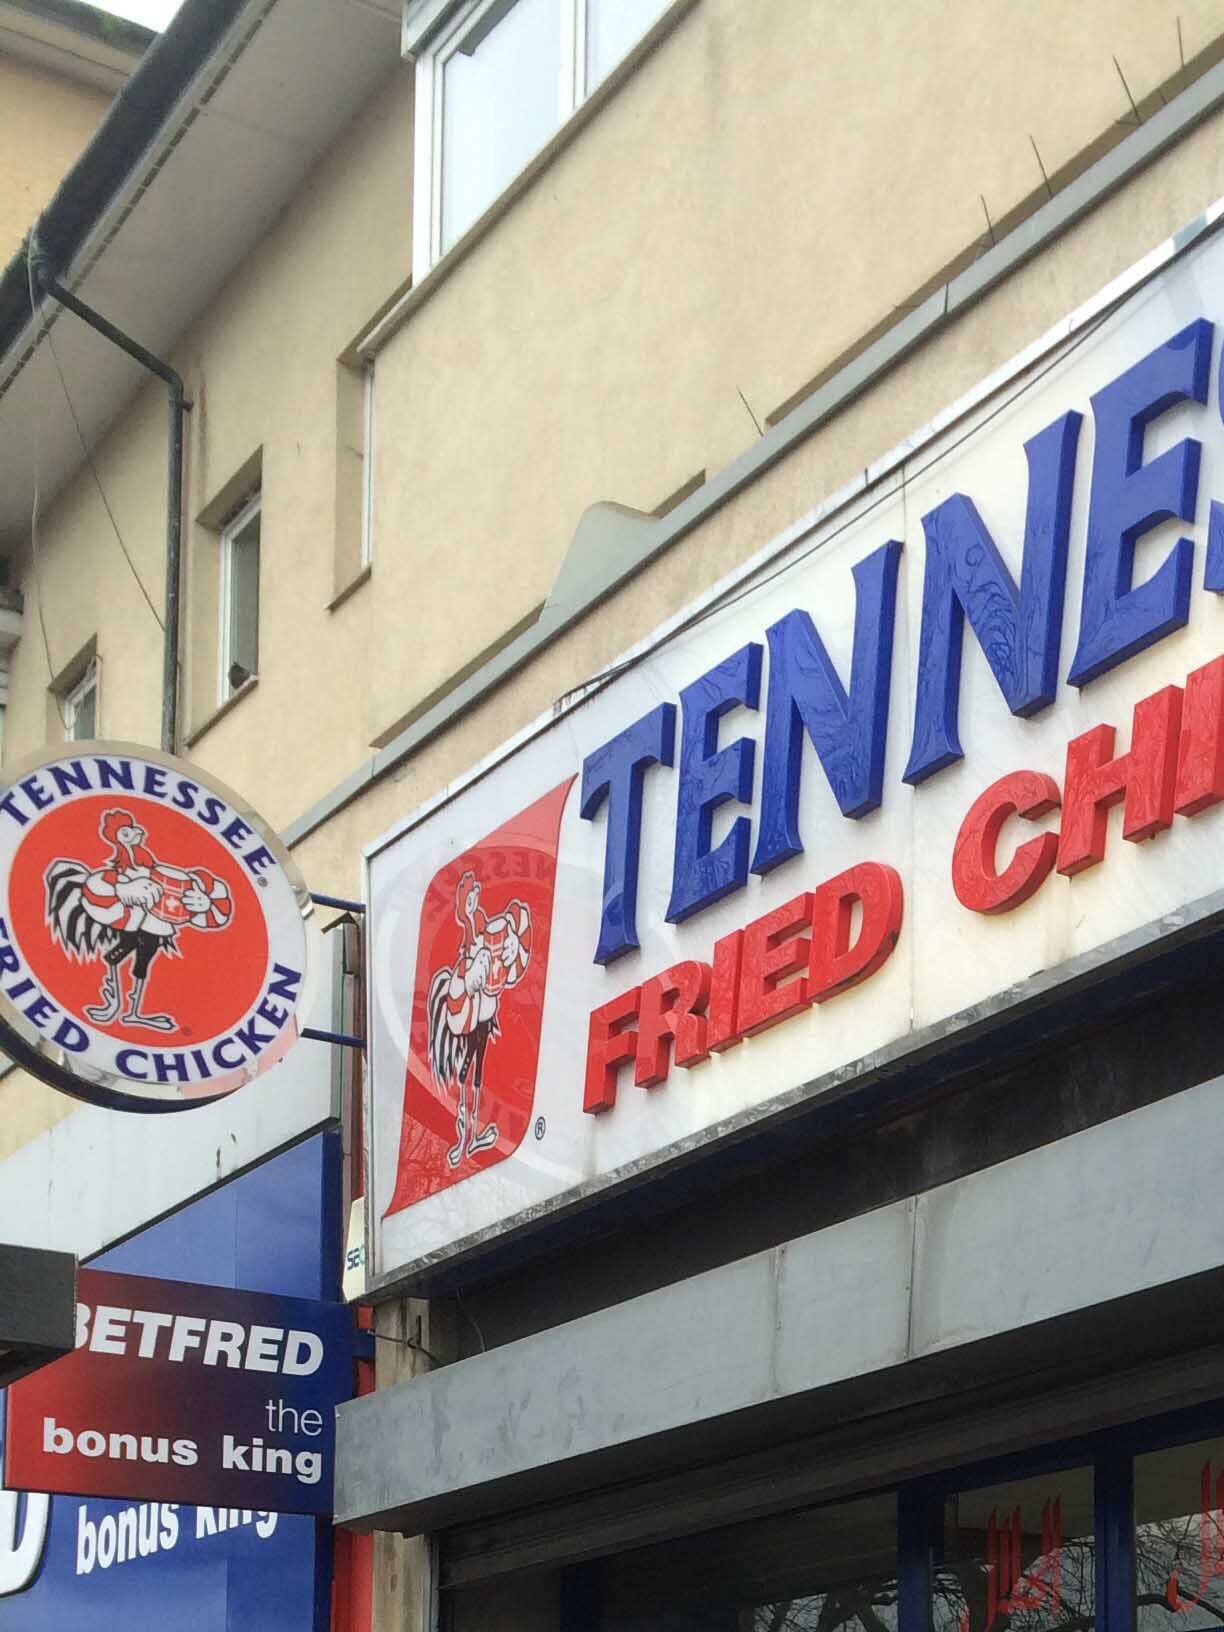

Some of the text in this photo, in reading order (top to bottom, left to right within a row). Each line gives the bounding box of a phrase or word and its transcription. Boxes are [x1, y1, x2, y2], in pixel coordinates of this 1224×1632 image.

[0, 757, 277, 876] TENNESSEE
[115, 962, 302, 1083] CHICKEN
[583, 861, 904, 1114] FRIED
[75, 1302, 324, 1377] BETFRED
[43, 1417, 322, 1484] bonus king
[266, 1399, 323, 1436] the
[76, 1502, 179, 1575] bonus
